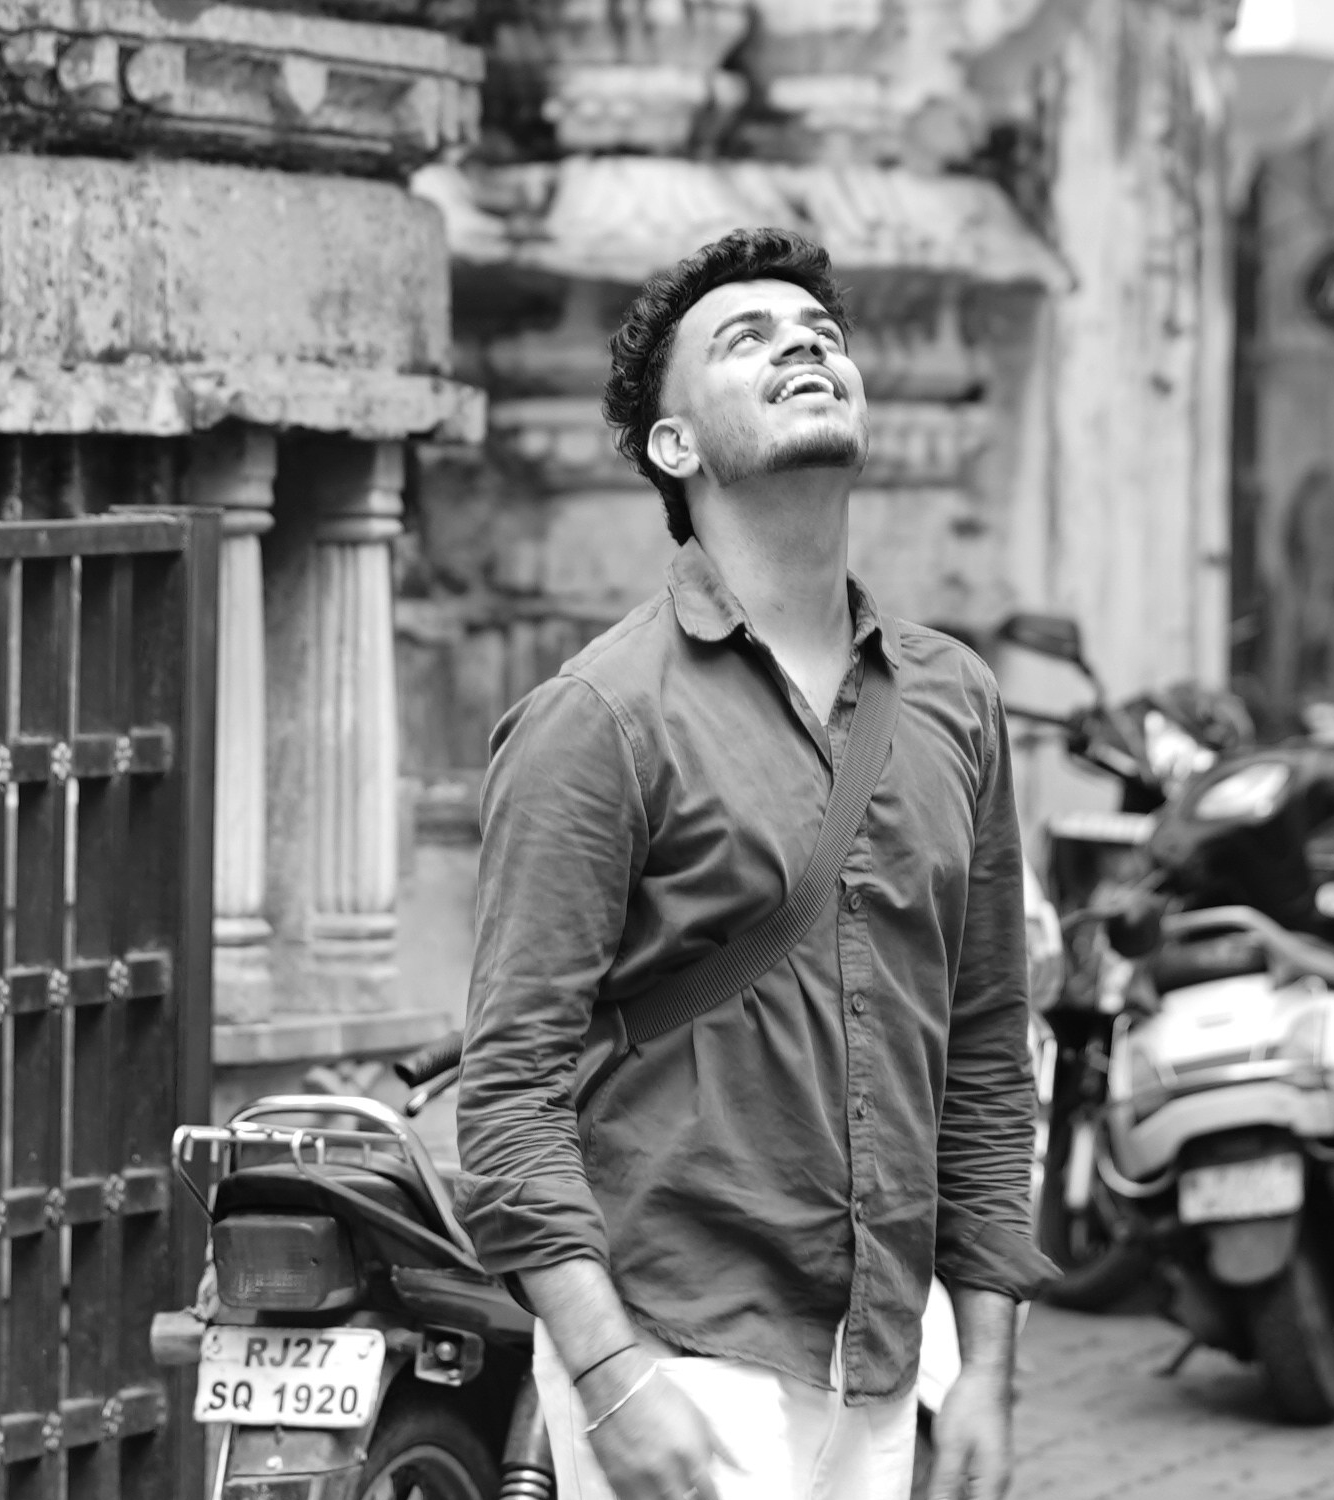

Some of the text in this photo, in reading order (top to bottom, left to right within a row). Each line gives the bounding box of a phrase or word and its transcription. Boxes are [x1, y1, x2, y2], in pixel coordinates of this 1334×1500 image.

[245, 1337, 336, 1368] RJ27
[209, 1380, 358, 1415] SQ 1920
